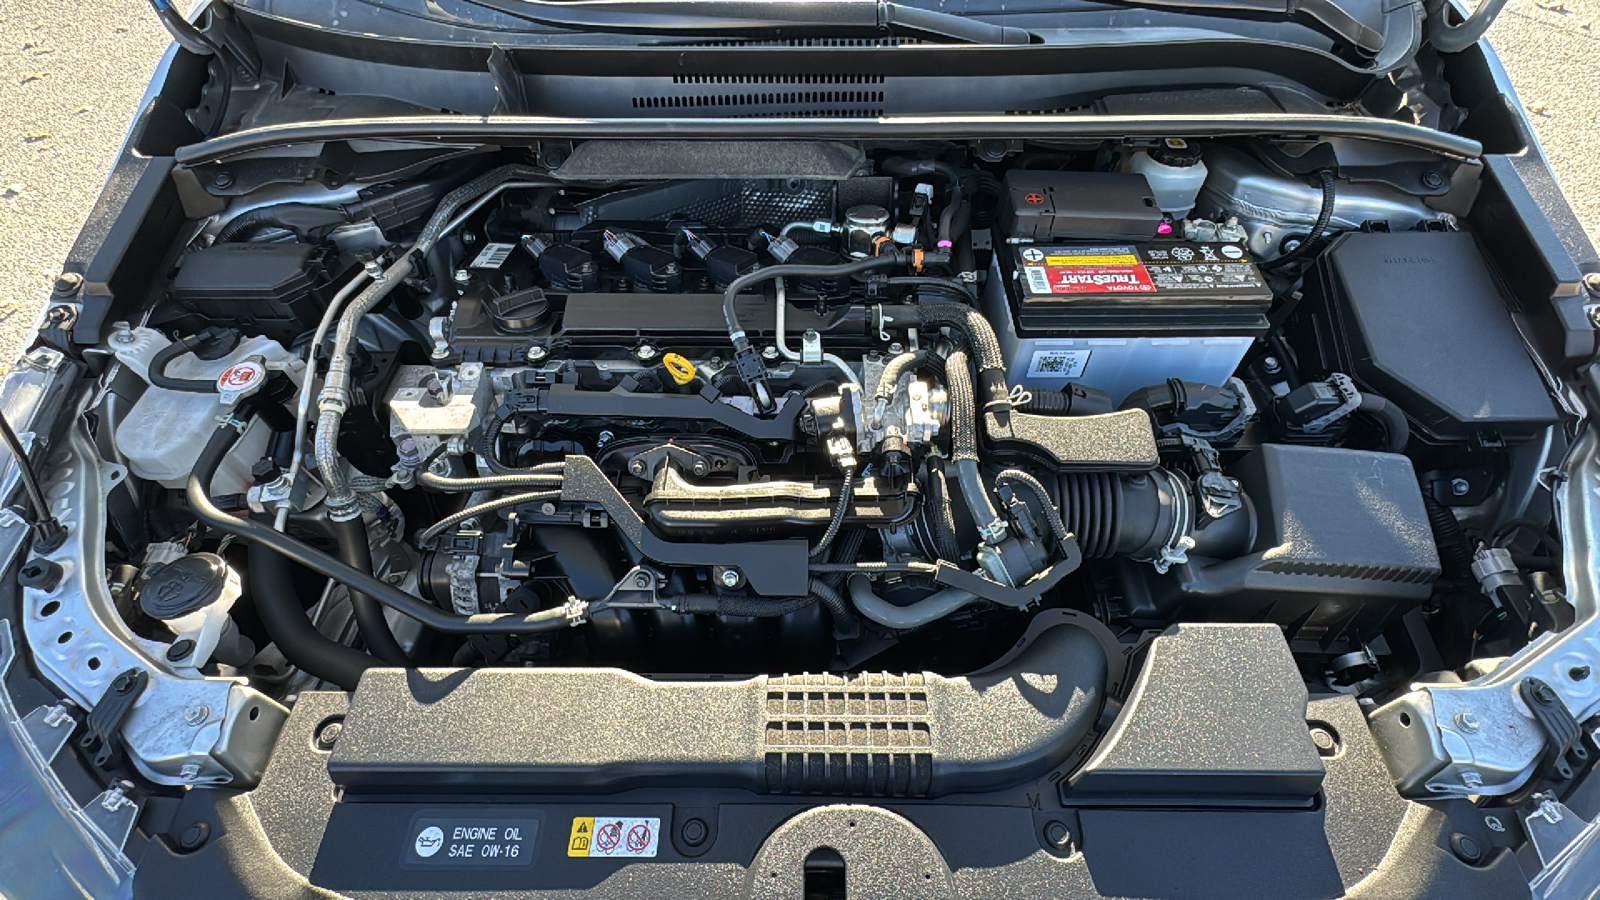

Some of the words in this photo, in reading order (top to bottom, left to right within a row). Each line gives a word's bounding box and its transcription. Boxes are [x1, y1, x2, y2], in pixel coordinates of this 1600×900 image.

[452, 827, 498, 840] ENGINE
[504, 827, 523, 841] OIL
[448, 844, 475, 858] SAE
[481, 844, 520, 858] 0W-16
